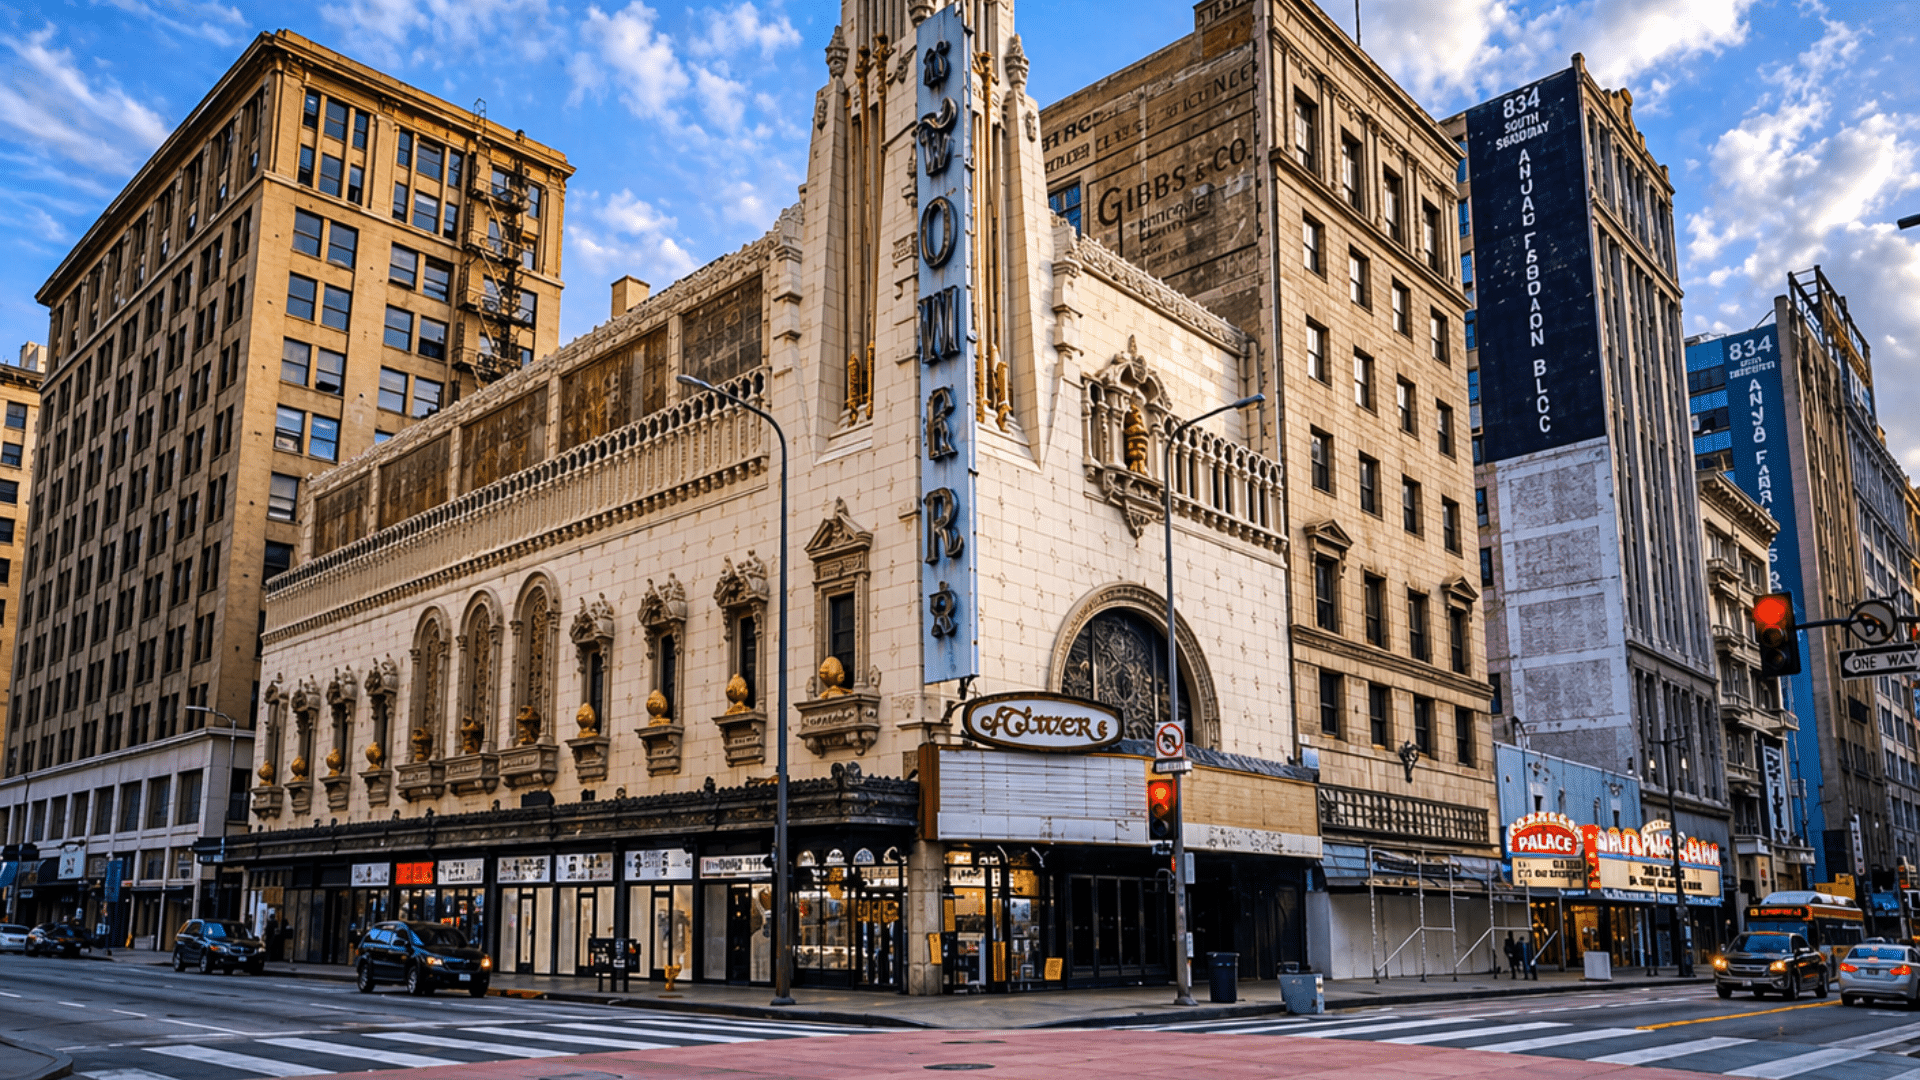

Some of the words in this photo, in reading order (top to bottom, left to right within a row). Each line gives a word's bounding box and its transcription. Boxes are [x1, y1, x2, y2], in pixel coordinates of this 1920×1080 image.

[1503, 86, 1541, 119] 834
[1504, 111, 1540, 134] SOUTH
[1098, 164, 1187, 226] GIBBS
[1729, 334, 1774, 361] 834
[1852, 655, 1877, 670] ONE
[1886, 652, 1918, 667] WAY
[1518, 833, 1573, 852] PALACE
